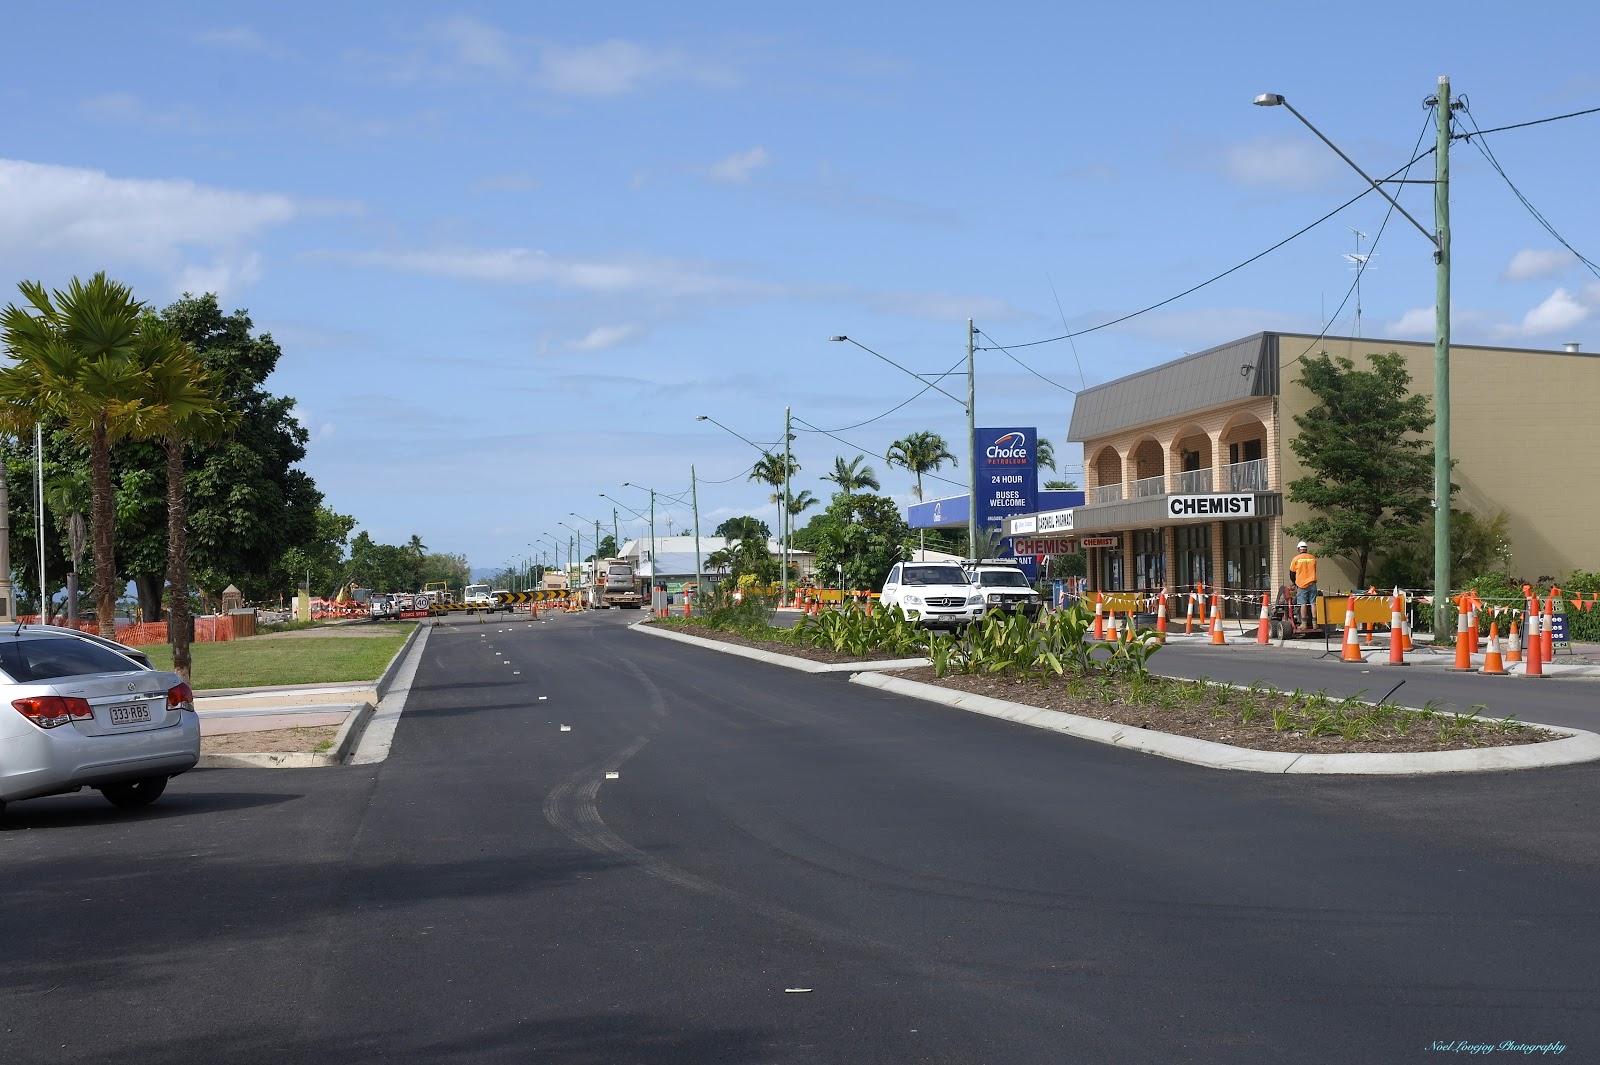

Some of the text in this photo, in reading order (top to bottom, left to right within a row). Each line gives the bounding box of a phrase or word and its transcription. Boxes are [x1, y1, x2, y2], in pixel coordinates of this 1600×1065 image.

[986, 446, 1027, 458] Choice
[991, 475, 1023, 484] 24 HOUR
[989, 498, 1026, 507] WELCOME
[1170, 497, 1252, 514] CHEMIST
[1015, 538, 1078, 555] CHEMIST
[1083, 538, 1113, 547] CHEMIST
